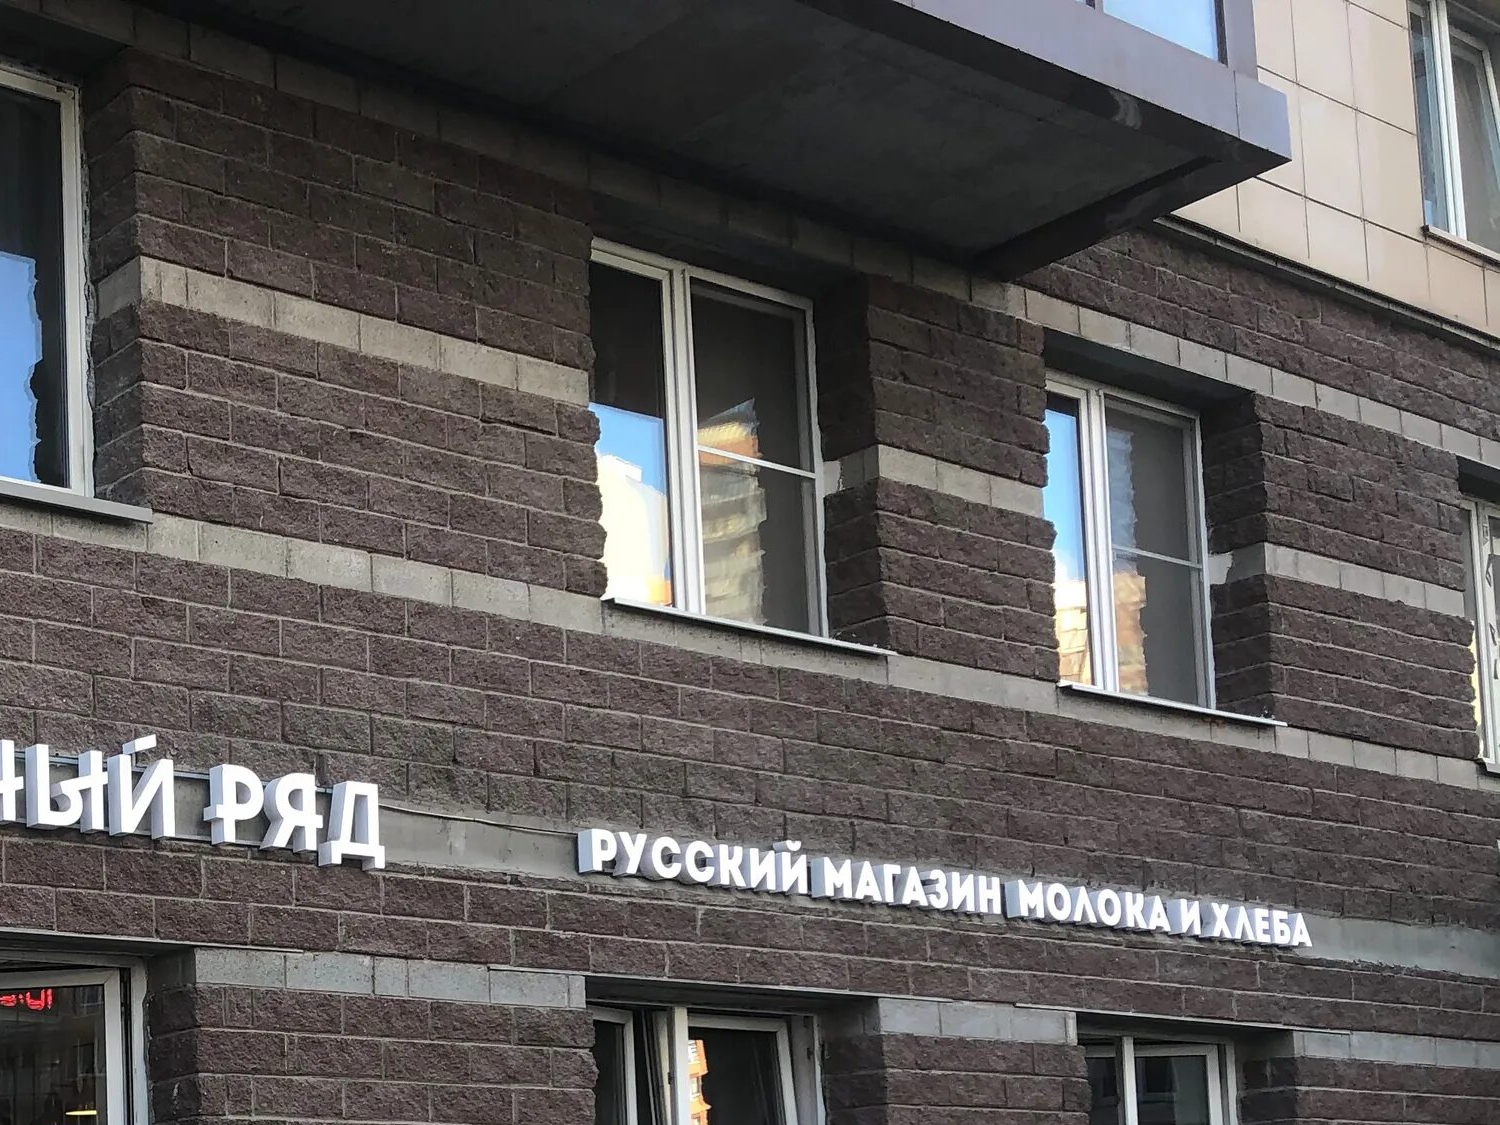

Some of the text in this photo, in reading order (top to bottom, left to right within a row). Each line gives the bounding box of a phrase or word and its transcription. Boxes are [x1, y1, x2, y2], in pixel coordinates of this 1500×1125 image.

[204, 763, 386, 869] РЯД
[578, 828, 1313, 948] РУССКИЙ МАГАЗИН МОЛОКА И ХЛЕБА
